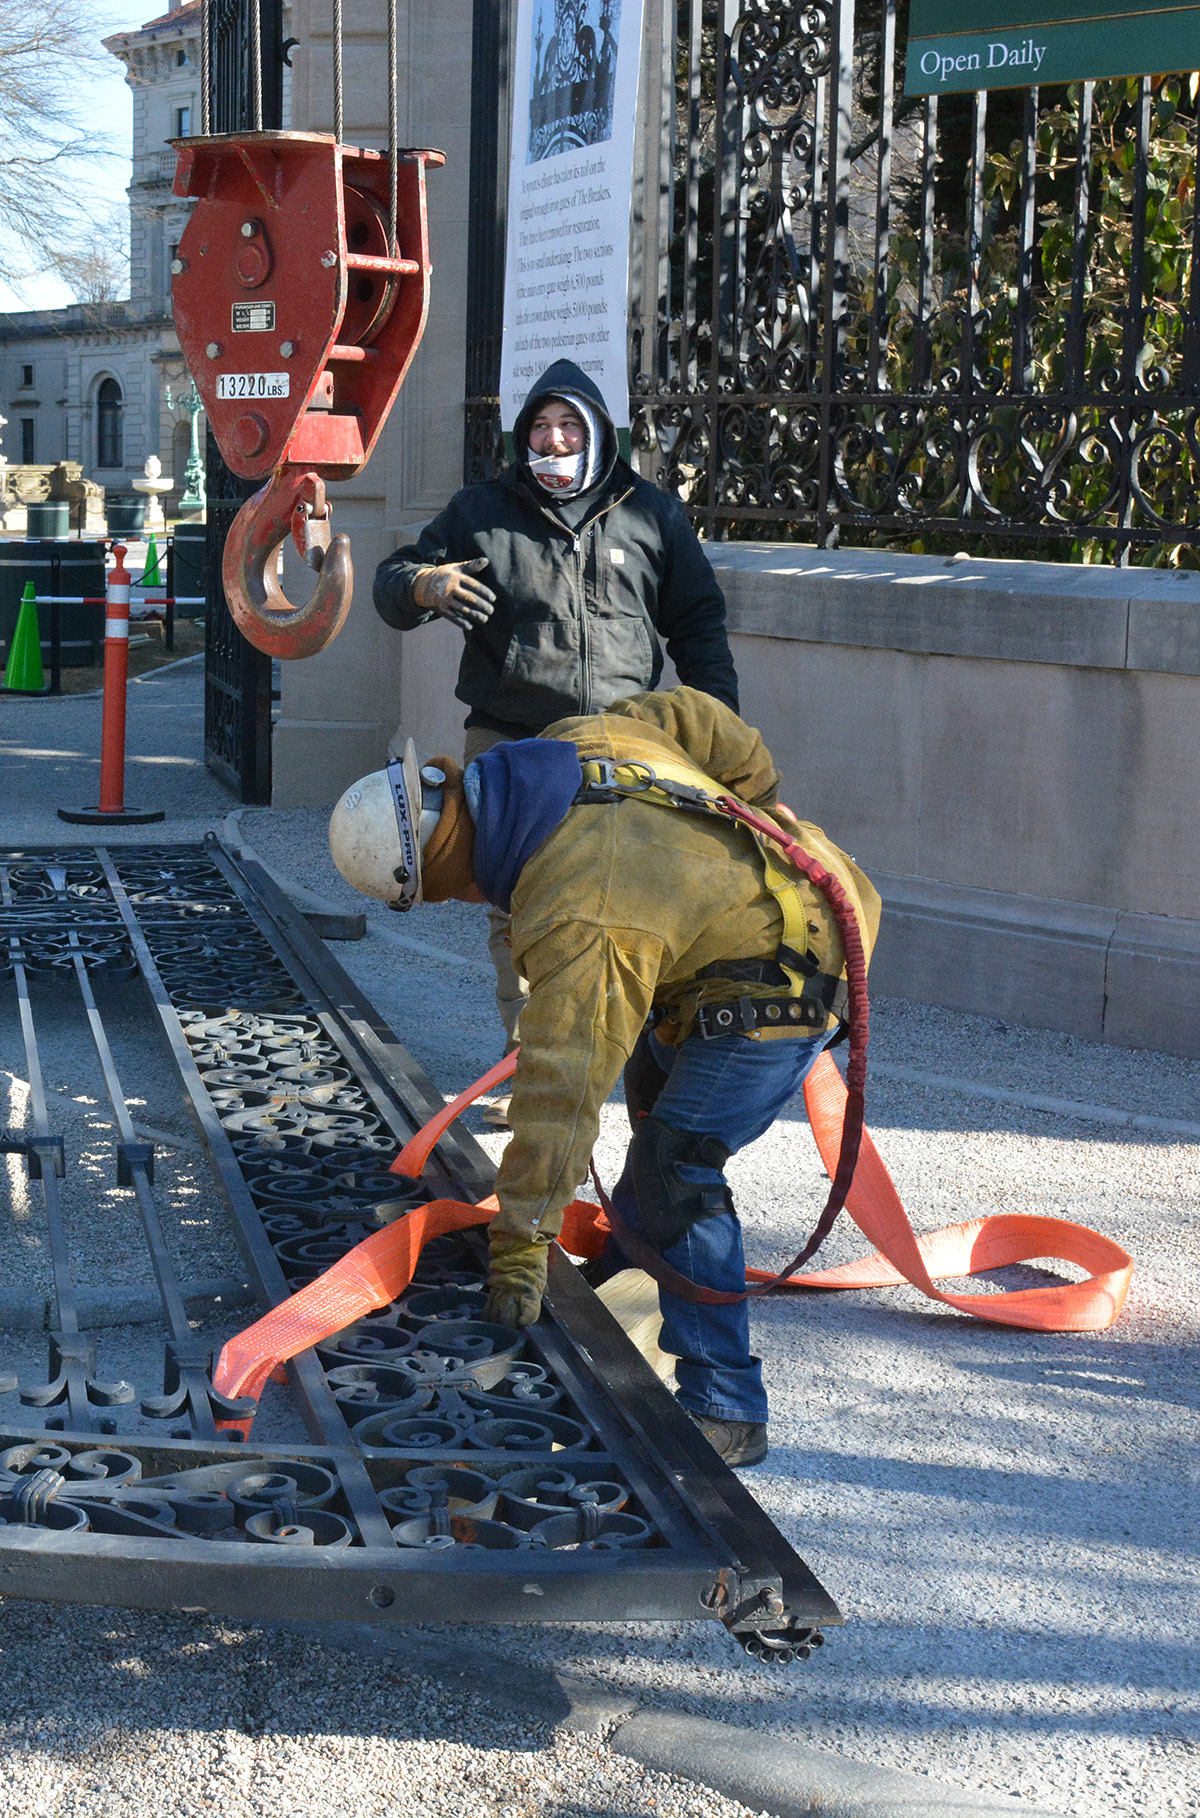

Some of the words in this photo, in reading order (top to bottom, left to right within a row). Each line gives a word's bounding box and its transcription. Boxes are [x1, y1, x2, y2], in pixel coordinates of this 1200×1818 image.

[920, 51, 980, 82] Open
[987, 39, 1047, 72] Daily
[580, 159, 589, 177] toll
[589, 163, 597, 176] on
[597, 156, 606, 173] the
[559, 197, 571, 216] gates
[576, 188, 588, 207] The
[573, 245, 583, 262] The
[583, 248, 593, 260] two
[594, 241, 614, 259] sections
[556, 274, 570, 298] weigh
[586, 269, 604, 293] pounds
[543, 304, 556, 321] above
[556, 302, 572, 324] weighs
[542, 337, 551, 348] two
[551, 330, 575, 353] pedestrian
[576, 333, 588, 351] gates
[588, 332, 596, 344] on
[596, 325, 610, 343] either
[220, 376, 266, 397] 13220
[267, 385, 285, 396] LBS.
